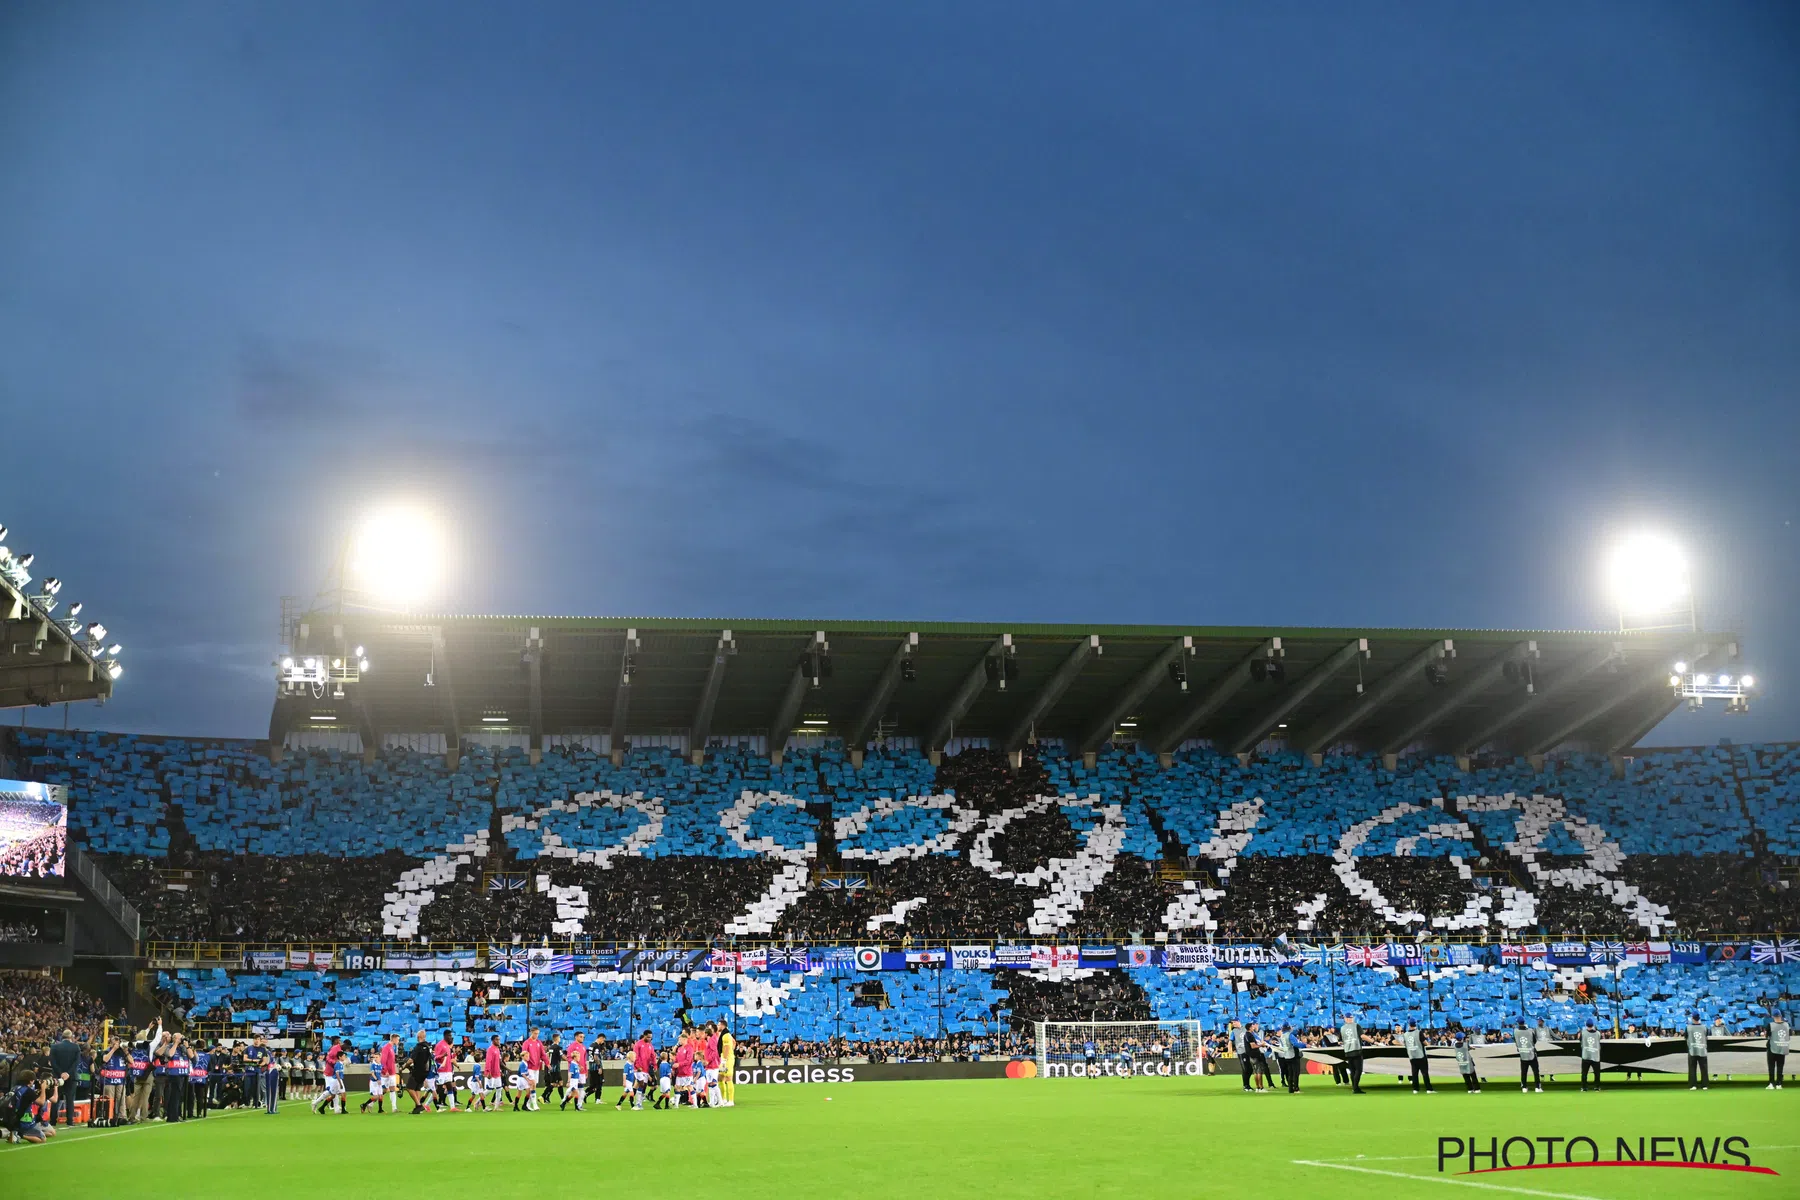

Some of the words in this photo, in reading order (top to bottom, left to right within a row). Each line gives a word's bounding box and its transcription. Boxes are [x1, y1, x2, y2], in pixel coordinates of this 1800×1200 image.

[639, 952, 689, 960] BRUGES
[954, 950, 988, 958] VOLKS
[1389, 943, 1421, 959] 1891
[346, 956, 381, 969] 1891
[963, 959, 979, 969] CLUB
[1176, 954, 1212, 964] BRUISERS!
[674, 963, 693, 972] DIE
[735, 1065, 855, 1084] priceless
